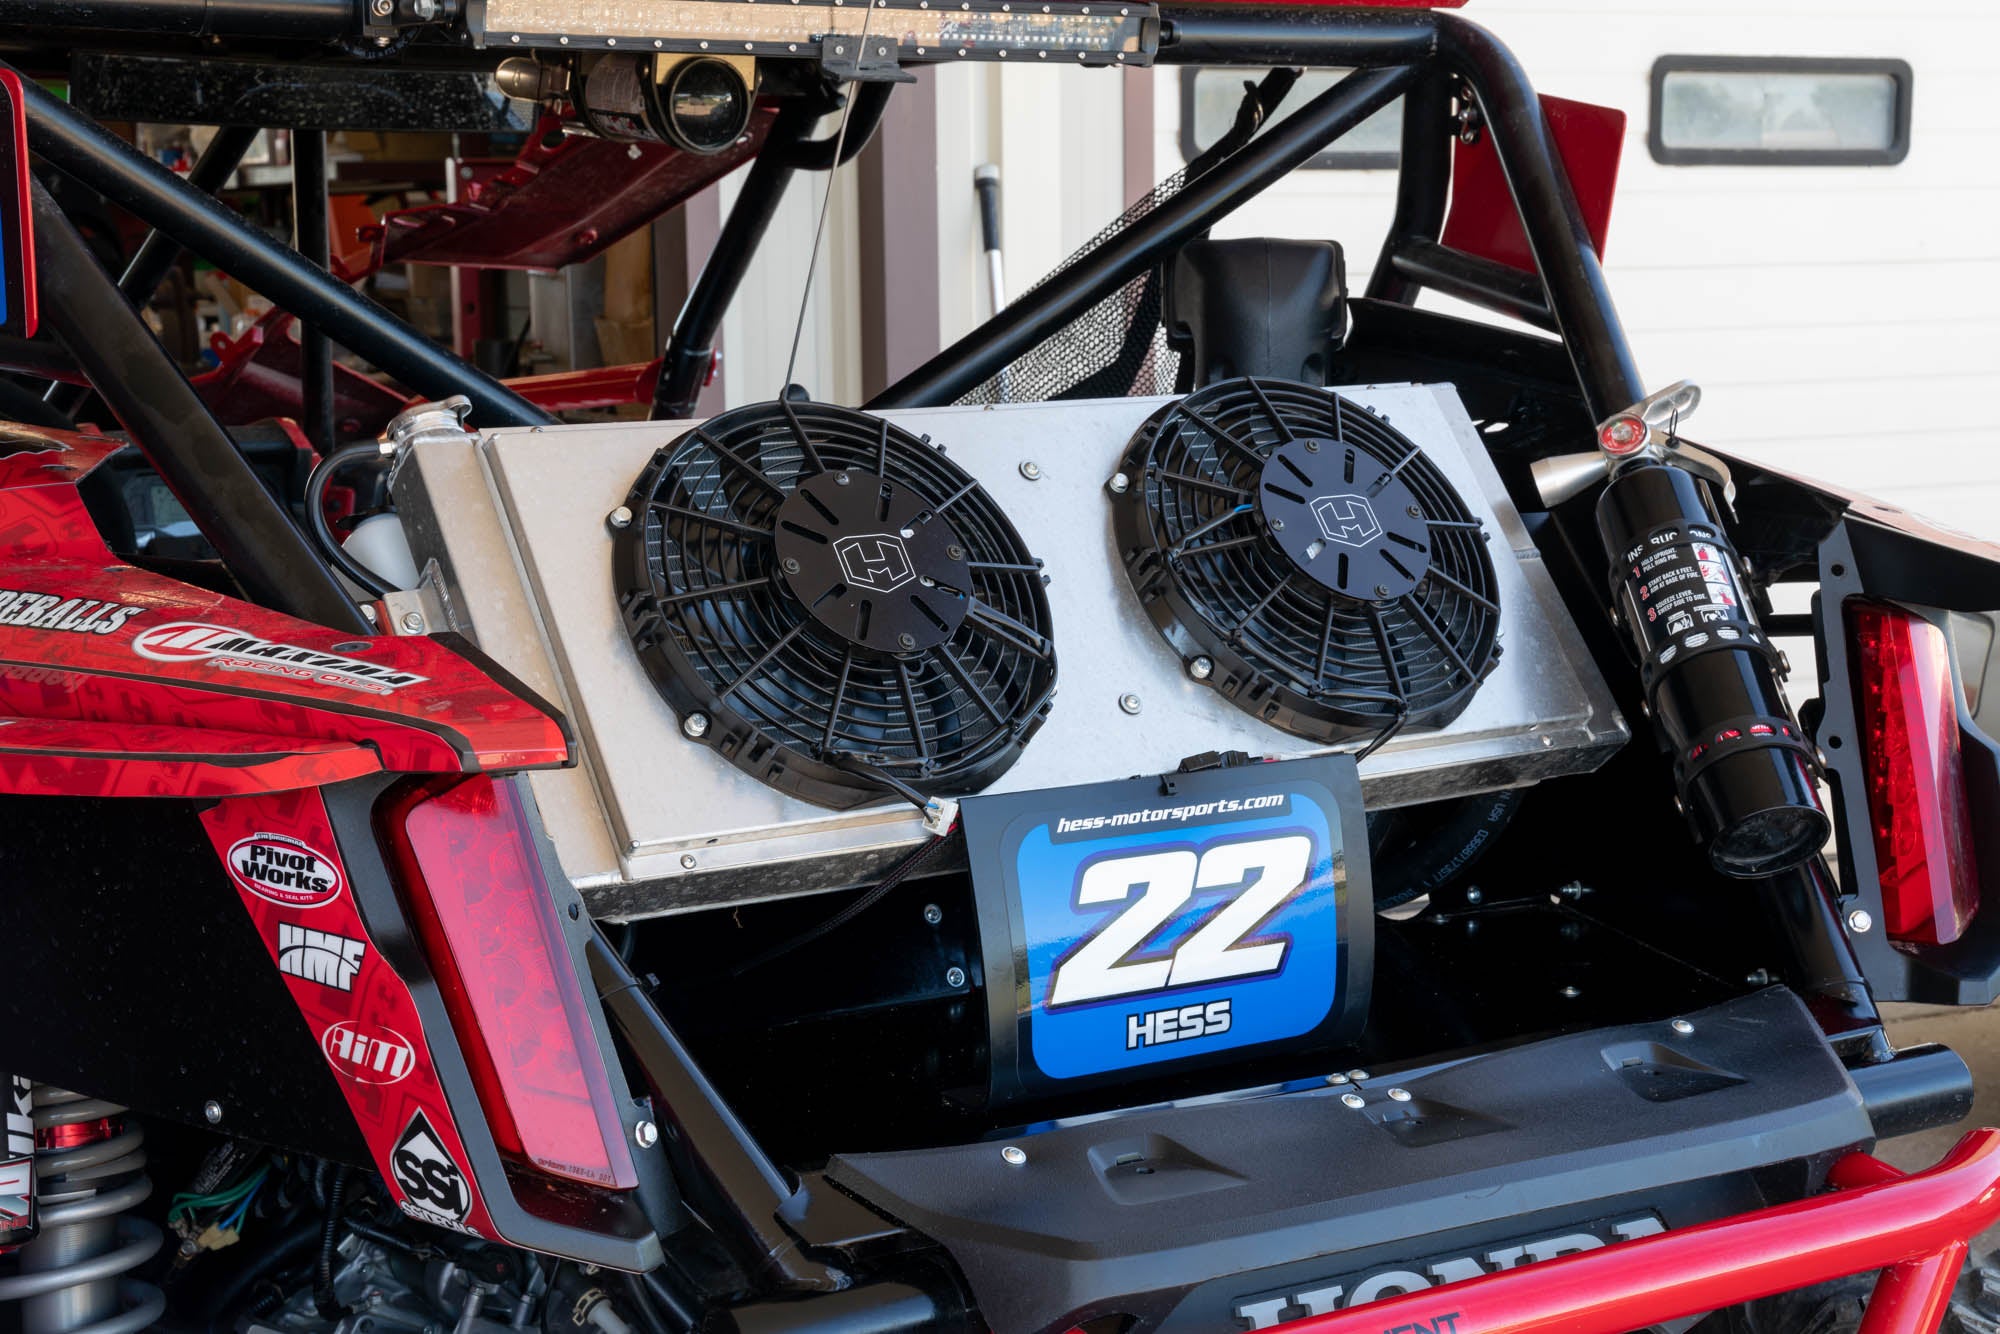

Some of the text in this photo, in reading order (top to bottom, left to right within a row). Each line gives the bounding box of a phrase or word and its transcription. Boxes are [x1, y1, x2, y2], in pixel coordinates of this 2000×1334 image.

[215, 657, 386, 692] RACING OILS
[1056, 793, 1285, 834] hess-motorsports.com
[241, 860, 328, 893] Works
[250, 844, 316, 873] Pivot
[1047, 835, 1312, 1006] 22
[278, 921, 367, 994] HMF
[1126, 998, 1232, 1050] HESS
